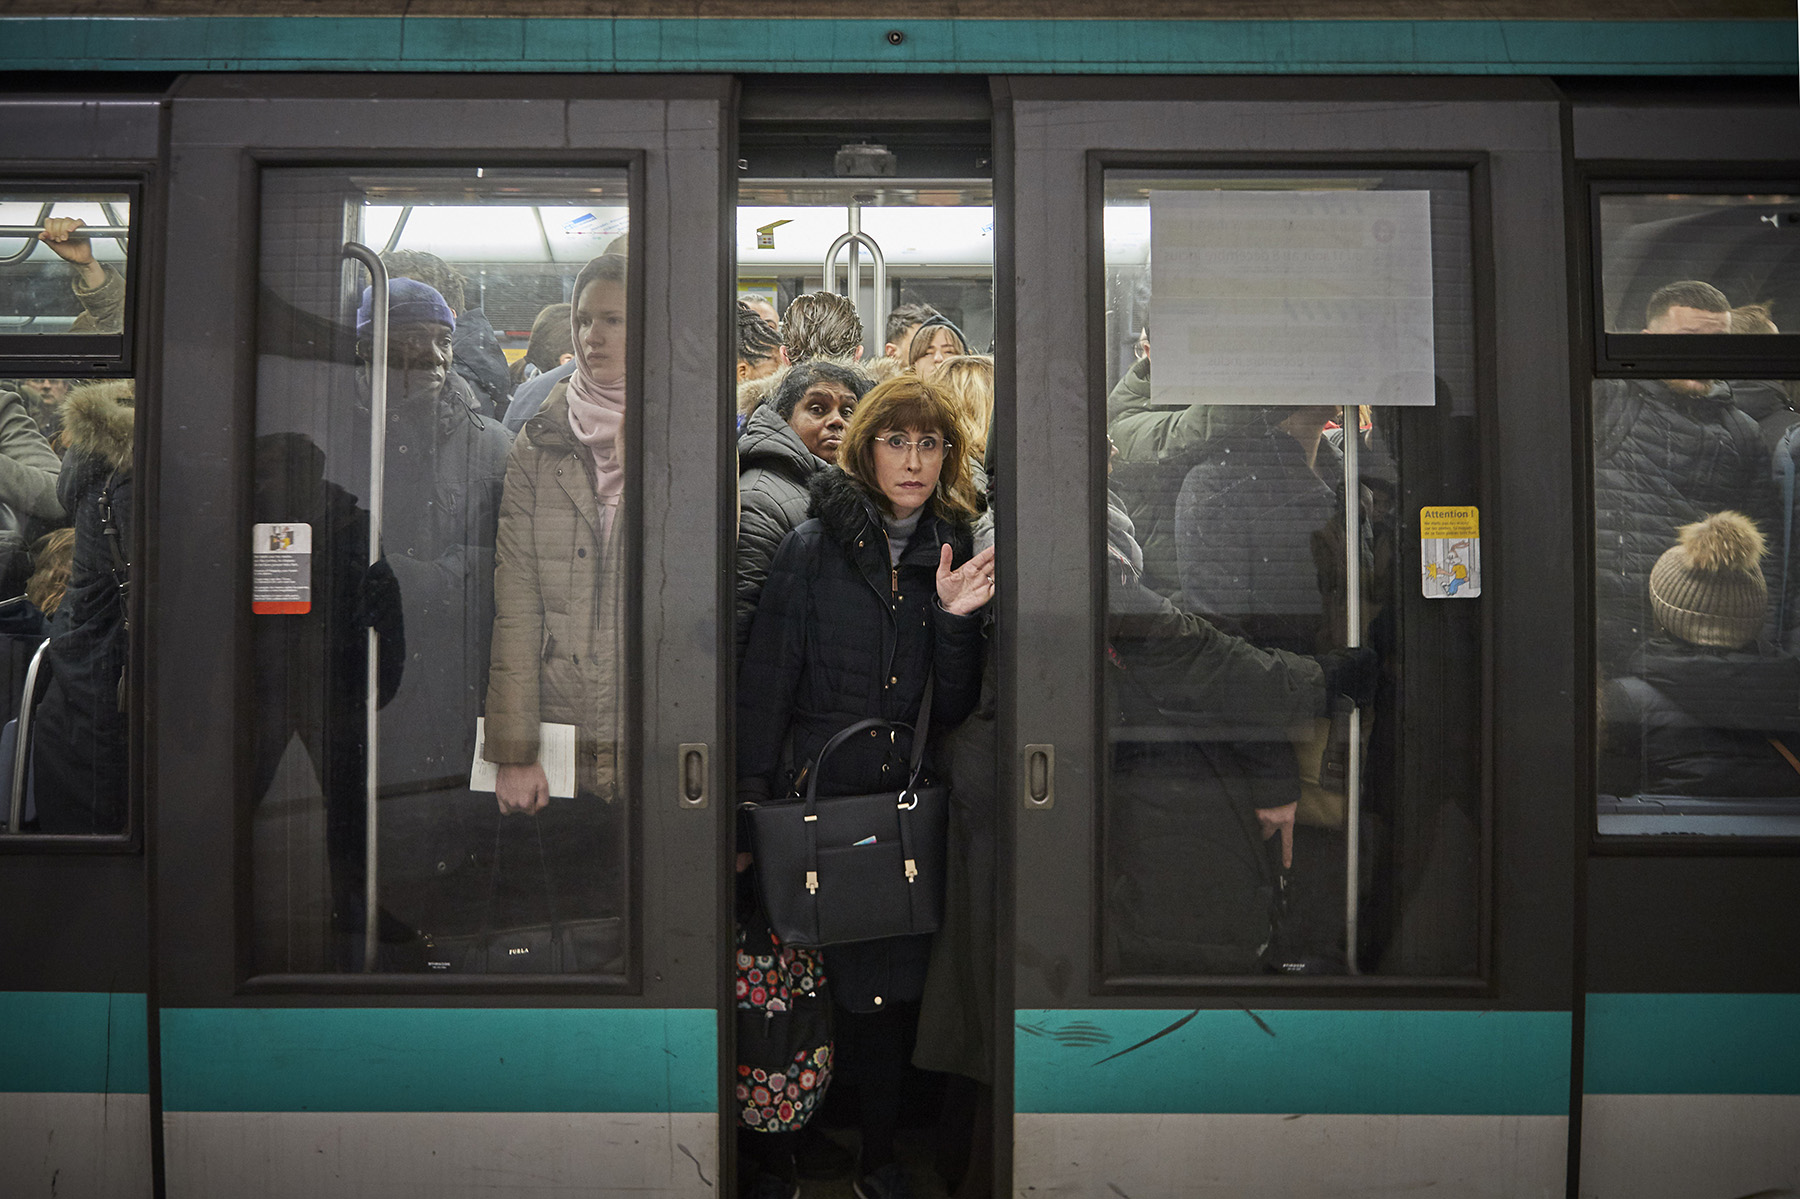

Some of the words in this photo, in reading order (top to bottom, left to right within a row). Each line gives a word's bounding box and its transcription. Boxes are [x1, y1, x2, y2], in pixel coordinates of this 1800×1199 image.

[1424, 509, 1468, 519] Attention
[1471, 509, 1474, 518] !
[508, 947, 529, 956] FURLA
